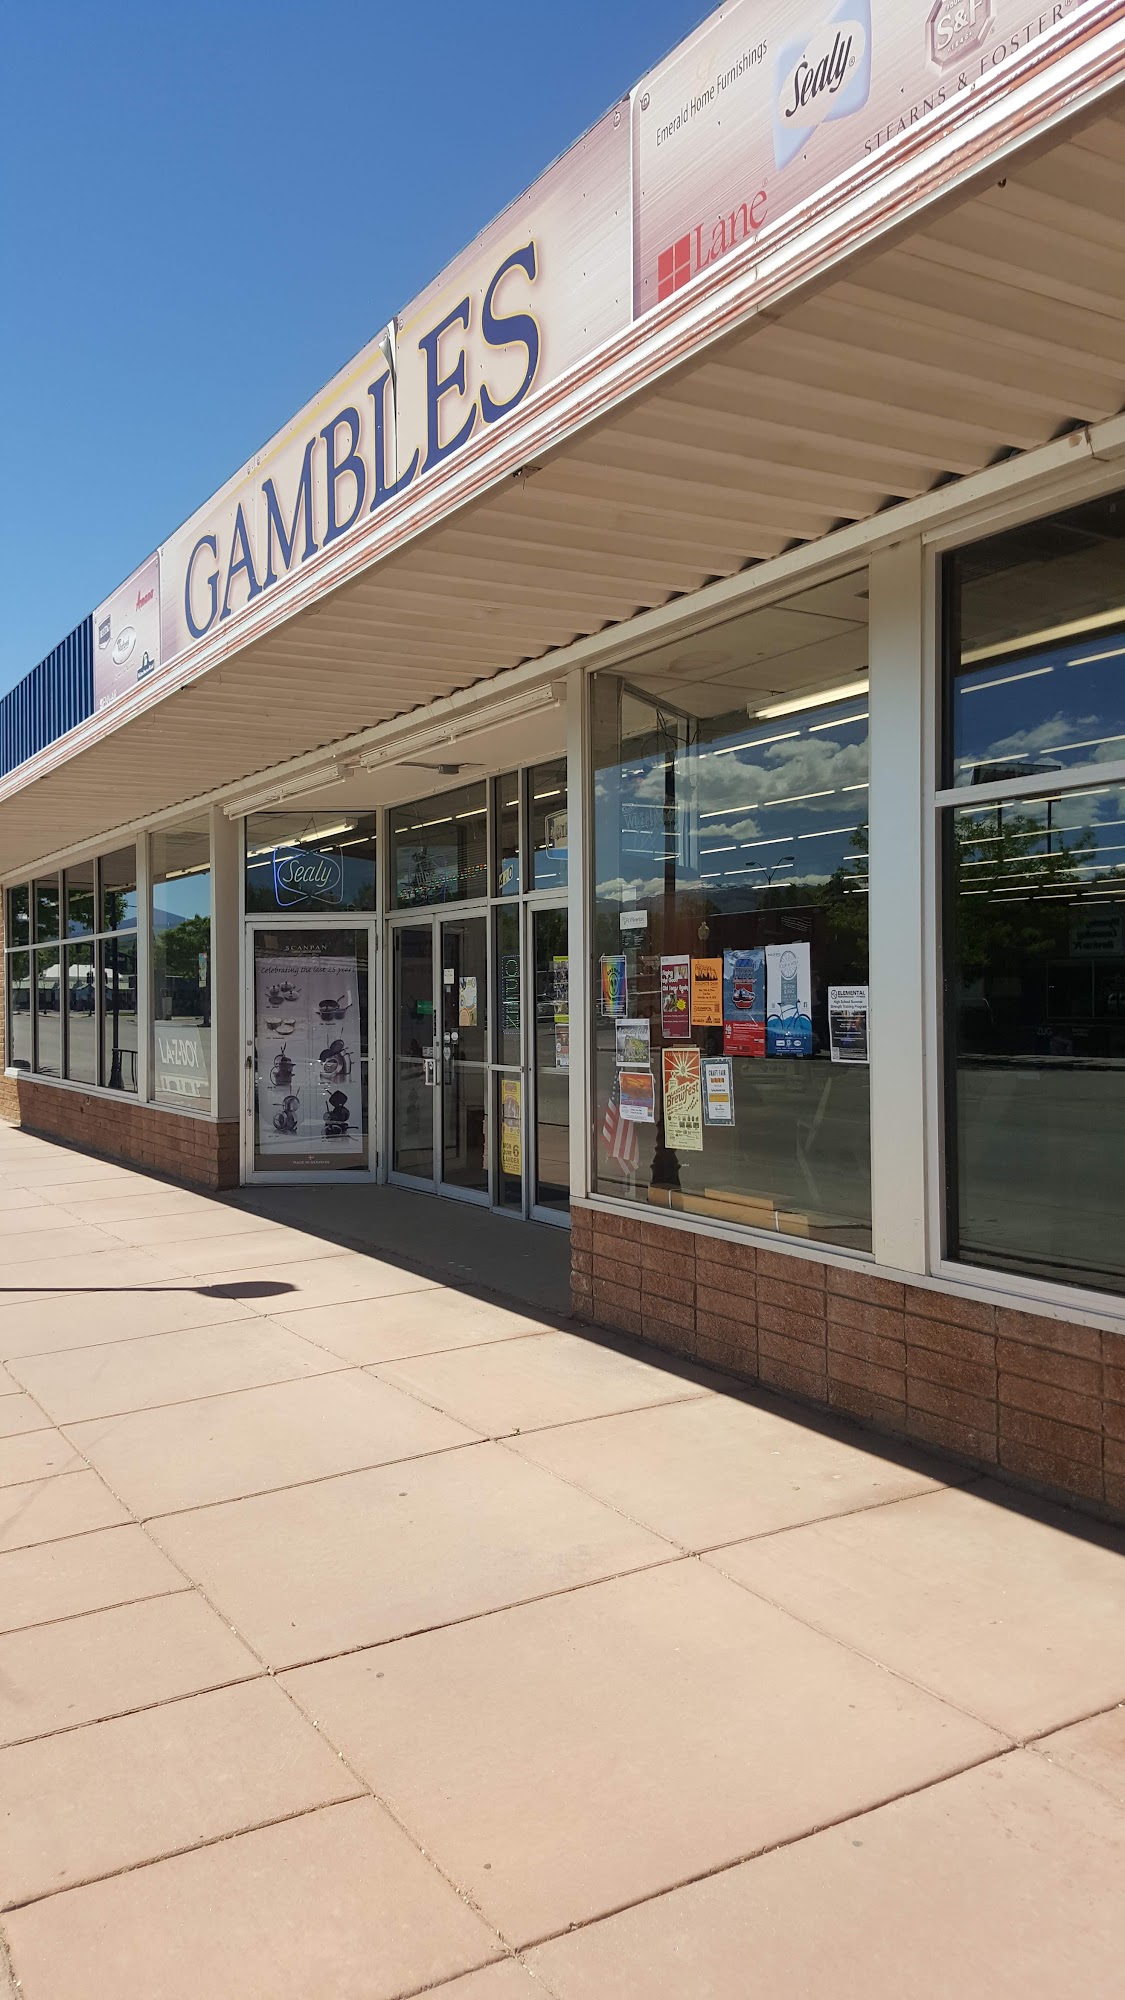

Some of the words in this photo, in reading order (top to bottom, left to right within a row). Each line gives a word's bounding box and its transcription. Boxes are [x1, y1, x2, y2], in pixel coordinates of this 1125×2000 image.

[656, 103, 689, 147] Emerald
[690, 85, 715, 118] Home
[717, 39, 768, 94] Furnishings
[785, 31, 853, 117] Sealy
[864, 86, 946, 157] STEARNS
[957, 72, 968, 91] &
[980, 3, 1068, 76] FOSTER
[694, 190, 769, 273] Lane
[184, 240, 539, 640] GAMBLES
[282, 859, 332, 887] Sealy
[260, 966, 299, 976] Celebrating
[300, 965, 311, 973] the
[313, 965, 326, 973] last
[666, 1081, 699, 1109] Brewfest
